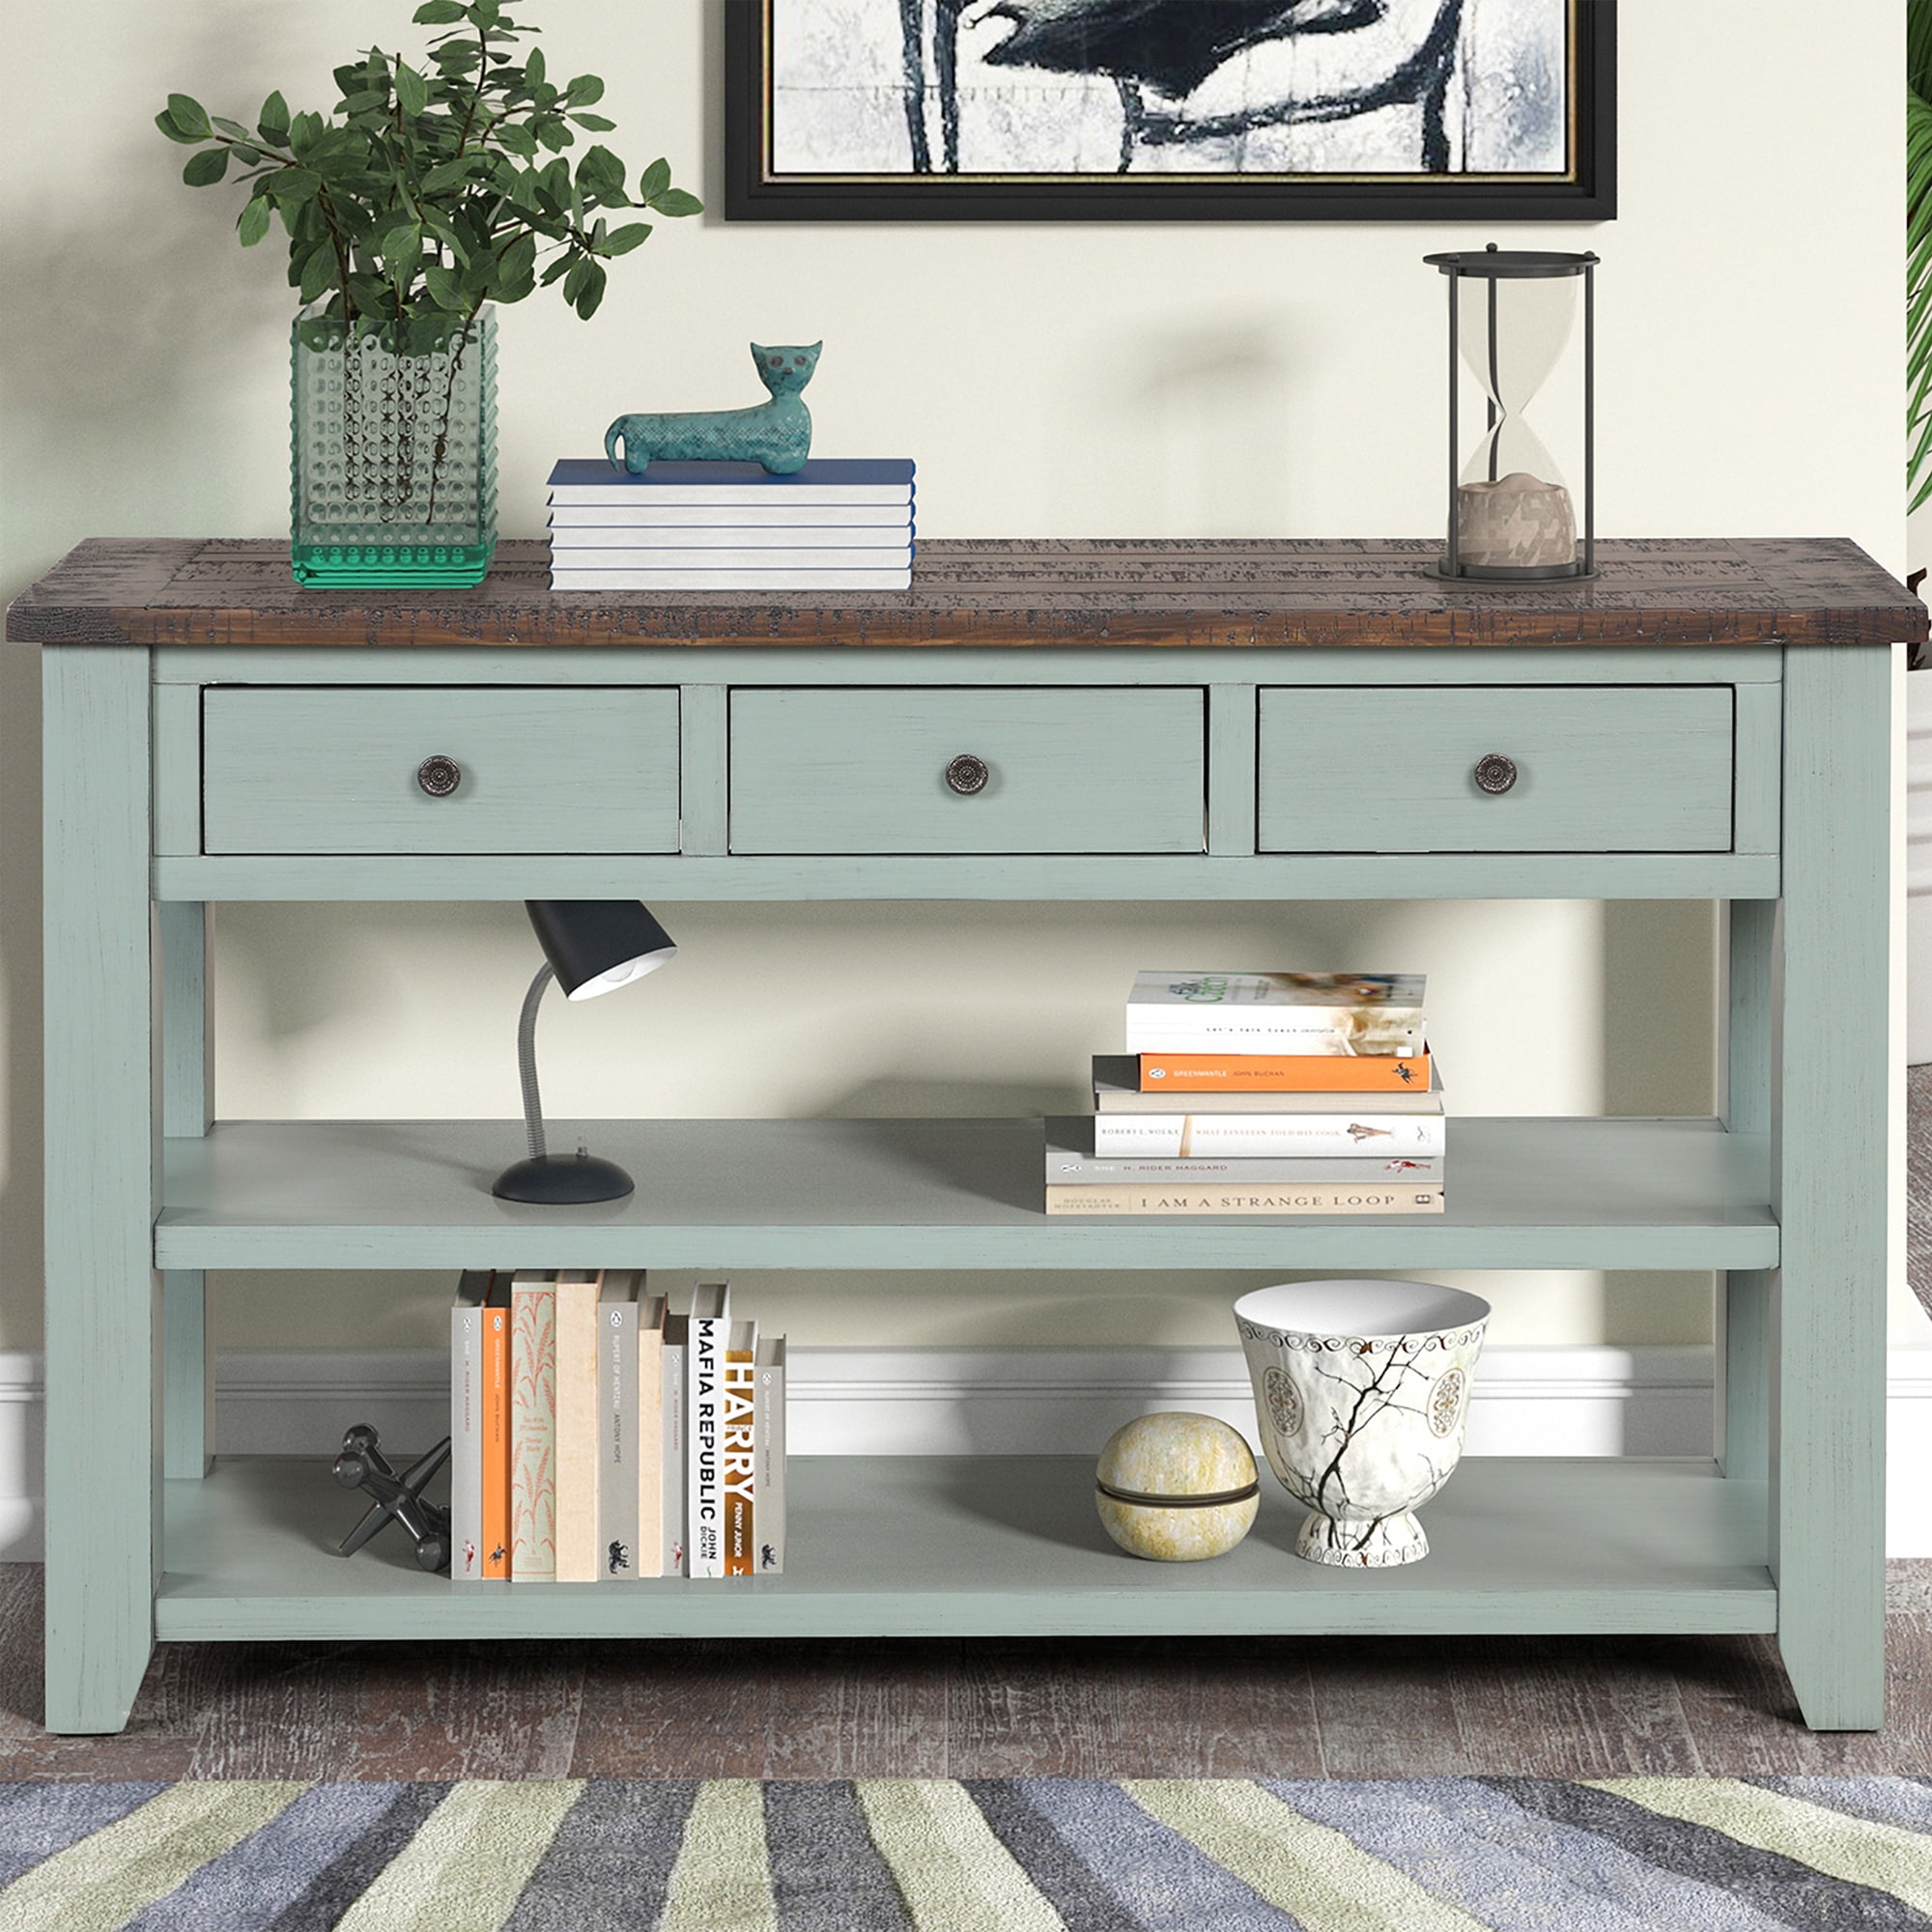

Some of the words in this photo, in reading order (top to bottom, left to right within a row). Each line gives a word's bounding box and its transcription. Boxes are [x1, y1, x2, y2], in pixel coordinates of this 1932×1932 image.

[1173, 1069, 1228, 1078] GREENMANTLE
[1142, 1198, 1147, 1208] I
[1157, 1198, 1188, 1208] AM
[1199, 1198, 1210, 1208] A
[1220, 1197, 1322, 1208] STRANGE
[1334, 1196, 1395, 1207] LOOP
[612, 1364, 620, 1374] OF
[698, 1320, 714, 1396] MAFIA
[724, 1362, 753, 1503] HARRY
[699, 1404, 716, 1520] REPUBLIC
[708, 1526, 717, 1559] JOHN
